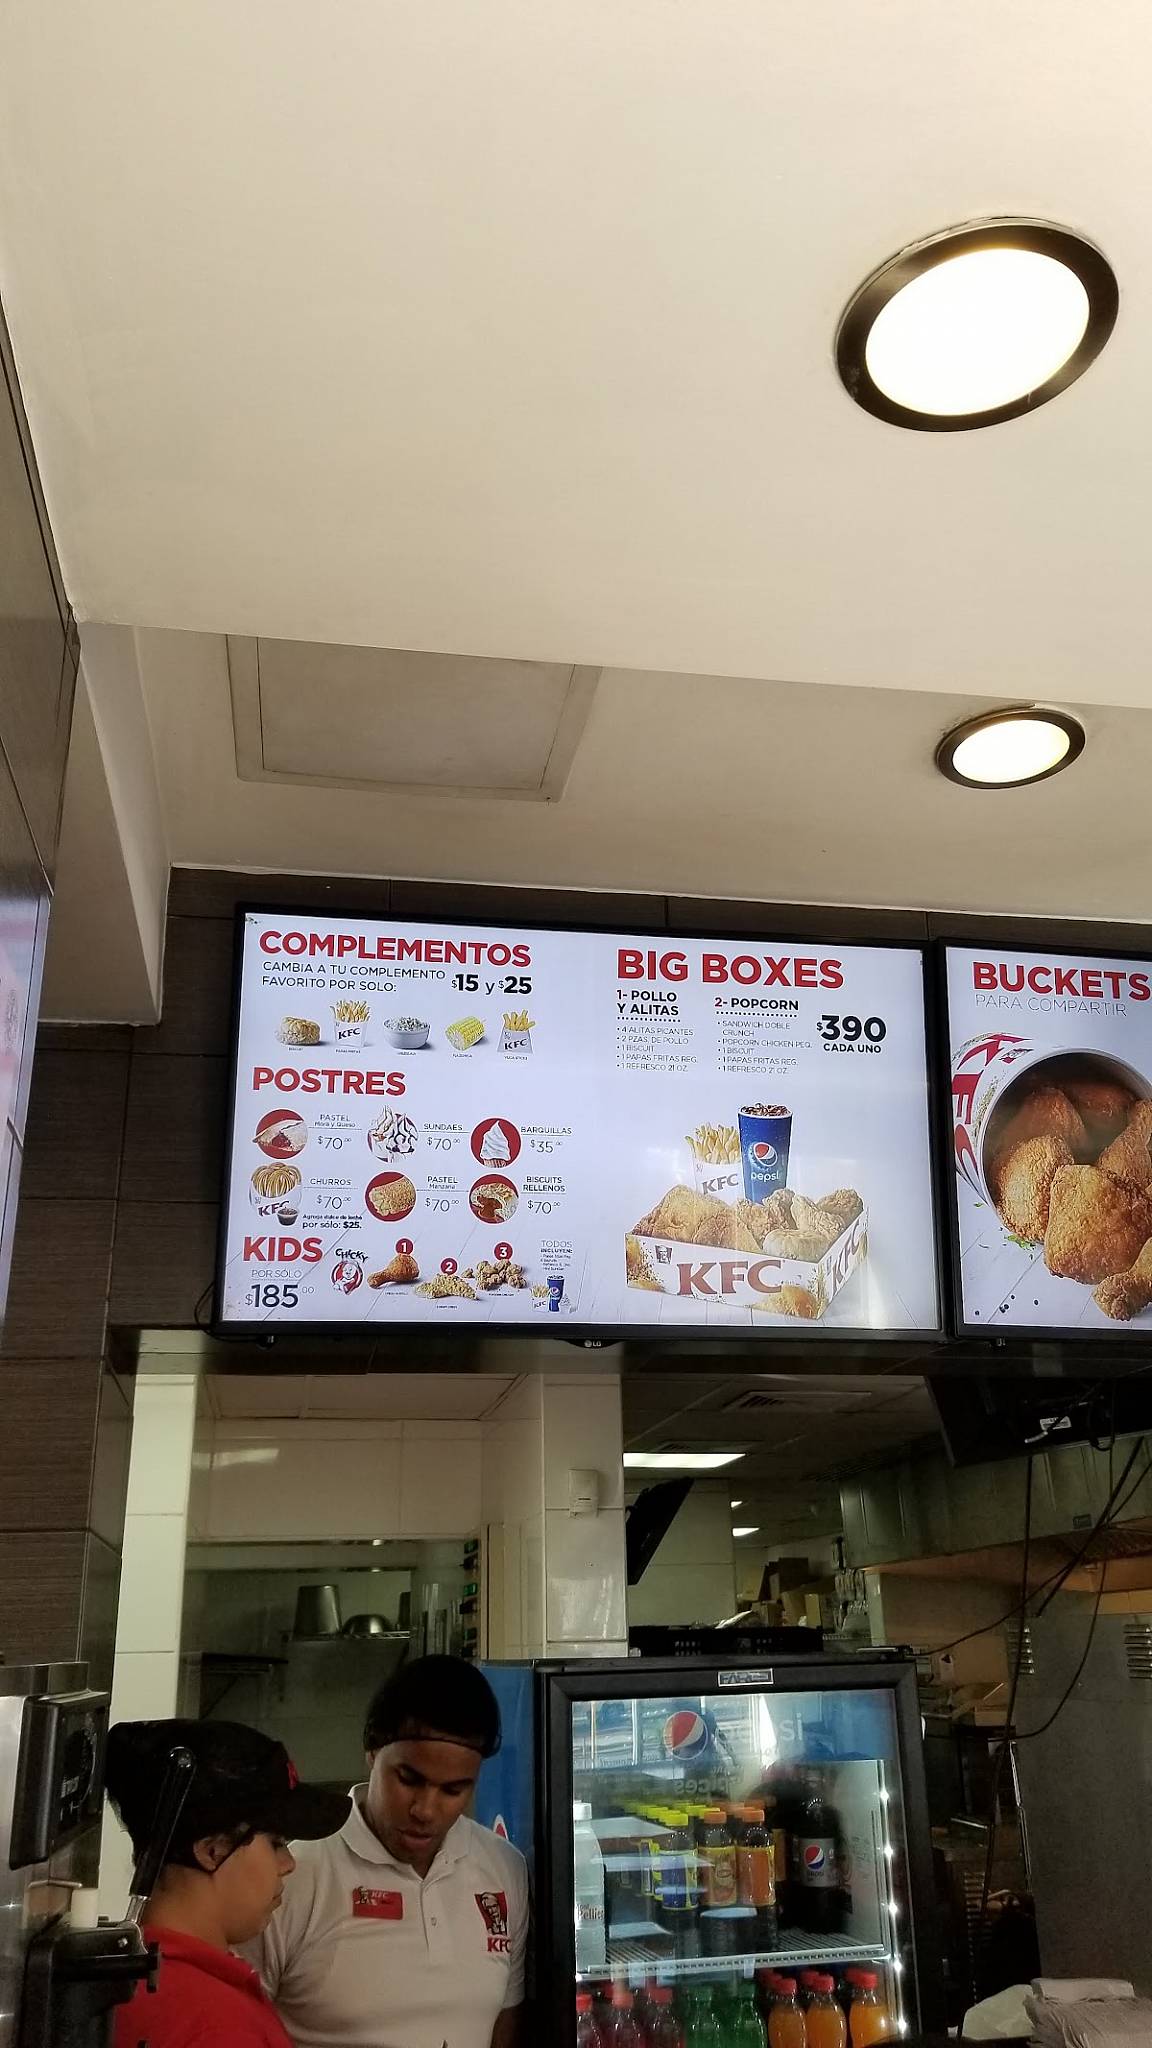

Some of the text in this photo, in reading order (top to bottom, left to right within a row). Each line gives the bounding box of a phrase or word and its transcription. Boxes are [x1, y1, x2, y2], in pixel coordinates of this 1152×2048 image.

[259, 930, 532, 968] COMPLEMENTOS
[263, 961, 446, 980] CAMBIA A TU COMPLEMENTO
[616, 949, 844, 989] BIG BOXES
[262, 976, 397, 992] FAVORITO POR SOLO:
[451, 973, 532, 995] $15 y $25
[972, 961, 1151, 1001] BUCKETS
[616, 989, 678, 1002] 1- POLLO
[616, 1003, 679, 1016] Y ALITAS
[714, 997, 799, 1011] 2- POPCORN
[976, 994, 1127, 1017] PARA COMPARTIR
[338, 1027, 361, 1040] KFC
[816, 1014, 887, 1043] $390
[504, 1038, 528, 1050] KFC
[823, 1043, 882, 1054] CADA UNO
[252, 1067, 406, 1097] POSTRES
[320, 1114, 350, 1122] PASTEL
[423, 1123, 463, 1131] SUNDAES
[520, 1126, 572, 1135] BARQUILLAS
[310, 1178, 352, 1186] CHURROS
[427, 1175, 458, 1184] PASTEL
[526, 1175, 563, 1184] BISCUITS
[750, 1169, 781, 1182] pepsi
[523, 1184, 566, 1192] RELLENOS
[702, 1173, 739, 1195] KFC
[302, 1221, 318, 1230] por
[320, 1220, 341, 1230] sólo:
[243, 1236, 323, 1263] KIDS
[401, 1242, 407, 1253] 1
[541, 1240, 573, 1248] TODOS
[499, 1247, 508, 1258] 3
[832, 1225, 860, 1291] KFC
[251, 1267, 302, 1278] POR SÓLO
[445, 1261, 453, 1272] 2
[676, 1260, 782, 1296] KFC
[245, 1284, 299, 1308] $185
